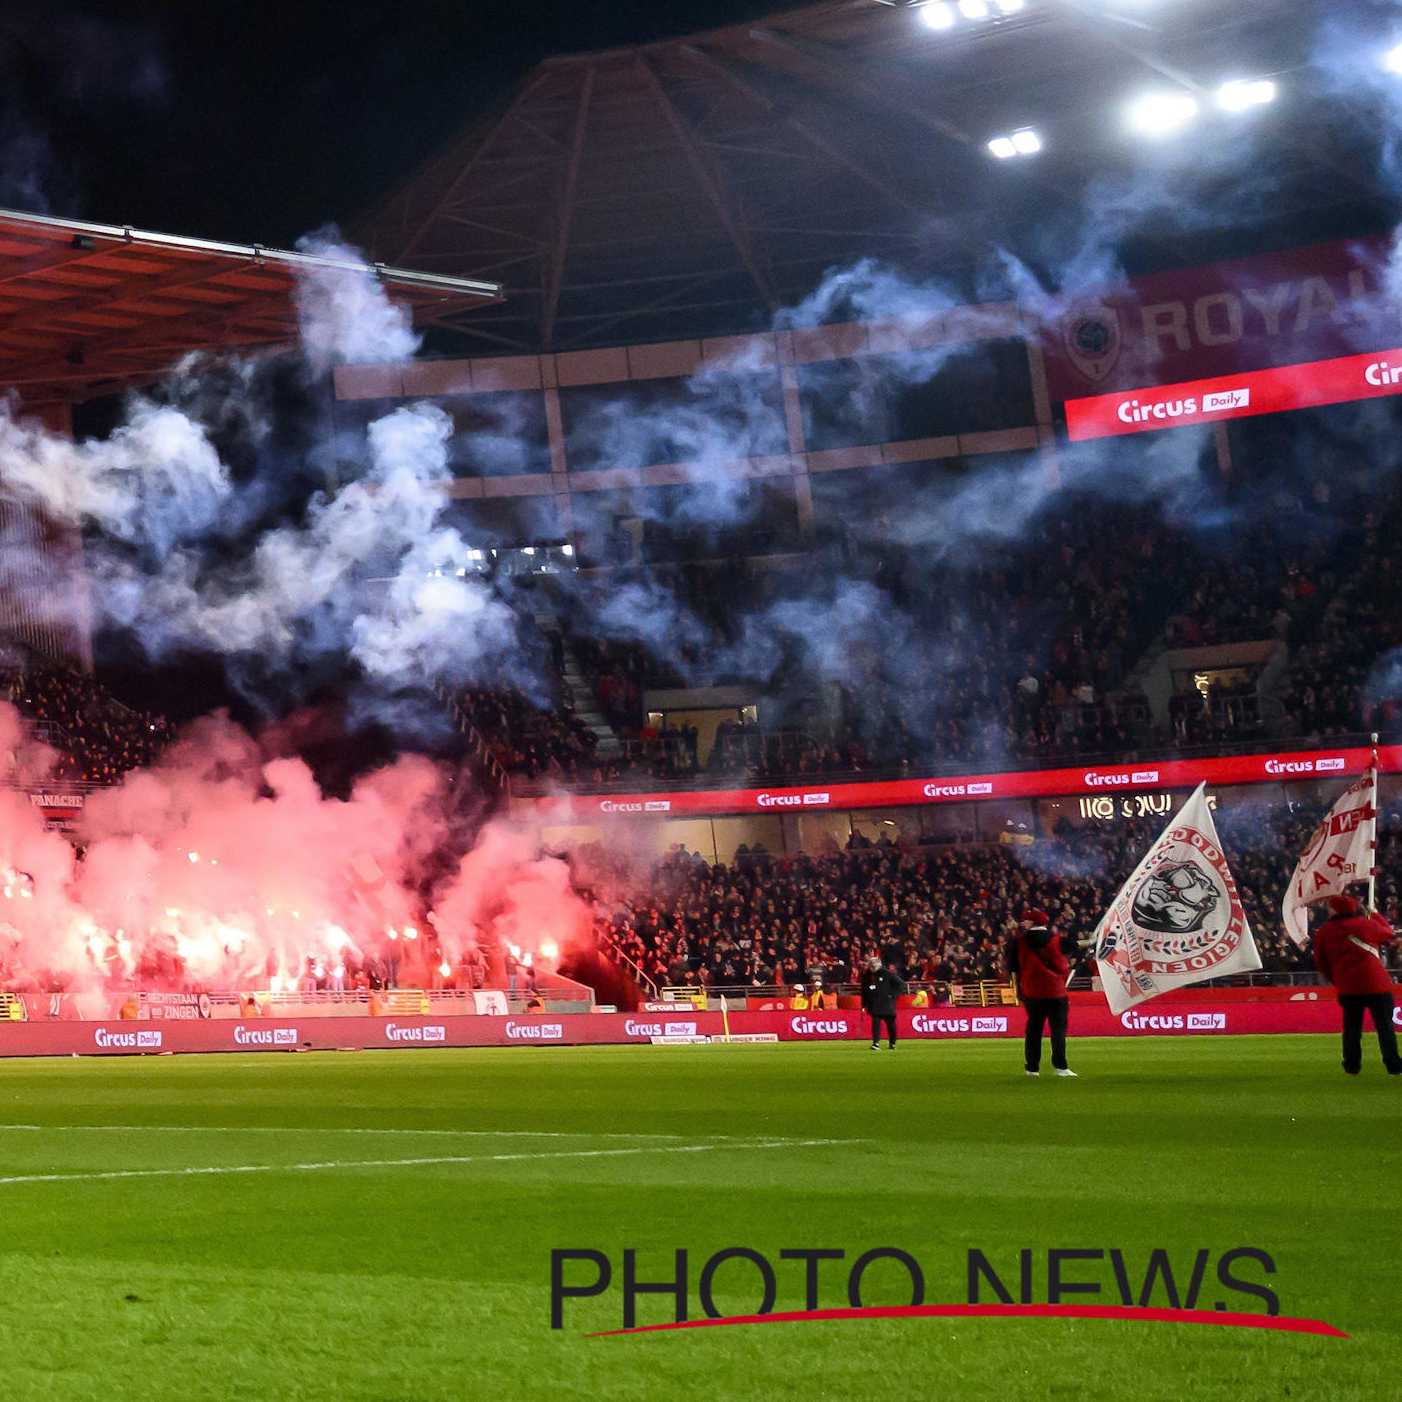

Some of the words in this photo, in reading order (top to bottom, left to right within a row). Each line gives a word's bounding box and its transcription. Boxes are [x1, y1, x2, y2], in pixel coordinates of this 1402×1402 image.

[1364, 361, 1402, 386] Cir
[1117, 399, 1197, 423] Circus
[1210, 391, 1243, 409] Daily
[1264, 758, 1313, 774] Circus
[1084, 772, 1130, 786] Circus
[924, 783, 965, 797] Circus
[600, 800, 642, 813] Circus
[757, 793, 802, 806] Circus
[148, 993, 199, 1004] RECHTSTAAN
[163, 1005, 199, 1019] ZINGEN
[1122, 1011, 1184, 1029] Circus
[1191, 1015, 1221, 1029] Daily
[506, 1021, 540, 1039] Circus
[625, 1019, 662, 1036] Circus
[669, 1024, 693, 1036] Daily
[791, 1016, 848, 1034] Circus
[911, 1013, 969, 1032] Circus
[976, 1019, 1004, 1032] Daily
[95, 1028, 136, 1047] Circus
[234, 1026, 272, 1045] Circus
[386, 1023, 422, 1041] Circus
